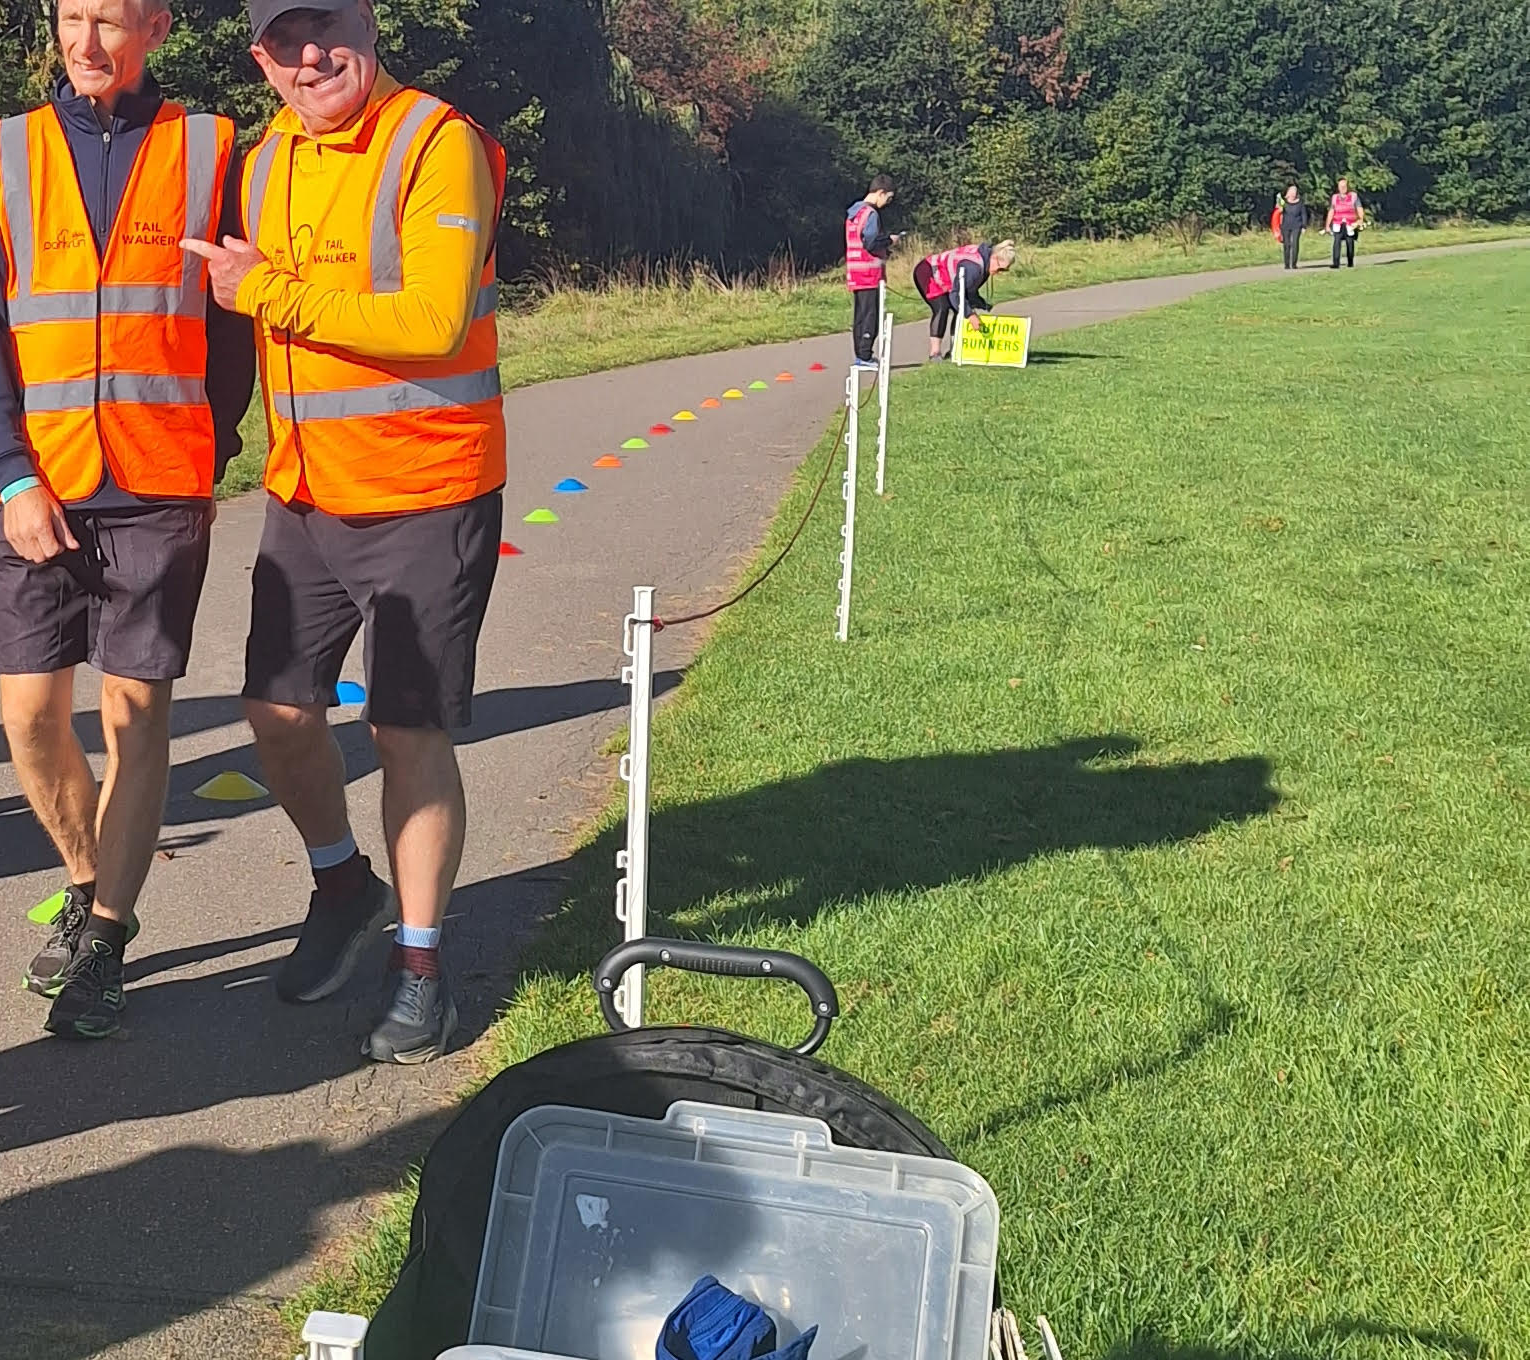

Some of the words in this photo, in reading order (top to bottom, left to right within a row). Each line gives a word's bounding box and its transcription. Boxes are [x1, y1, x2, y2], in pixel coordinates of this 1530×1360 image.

[134, 221, 162, 233] TAIL
[122, 234, 176, 246] WALKER
[326, 240, 344, 250] TAIL
[313, 252, 357, 265] WALKER
[962, 337, 1020, 352] RUNNERS
